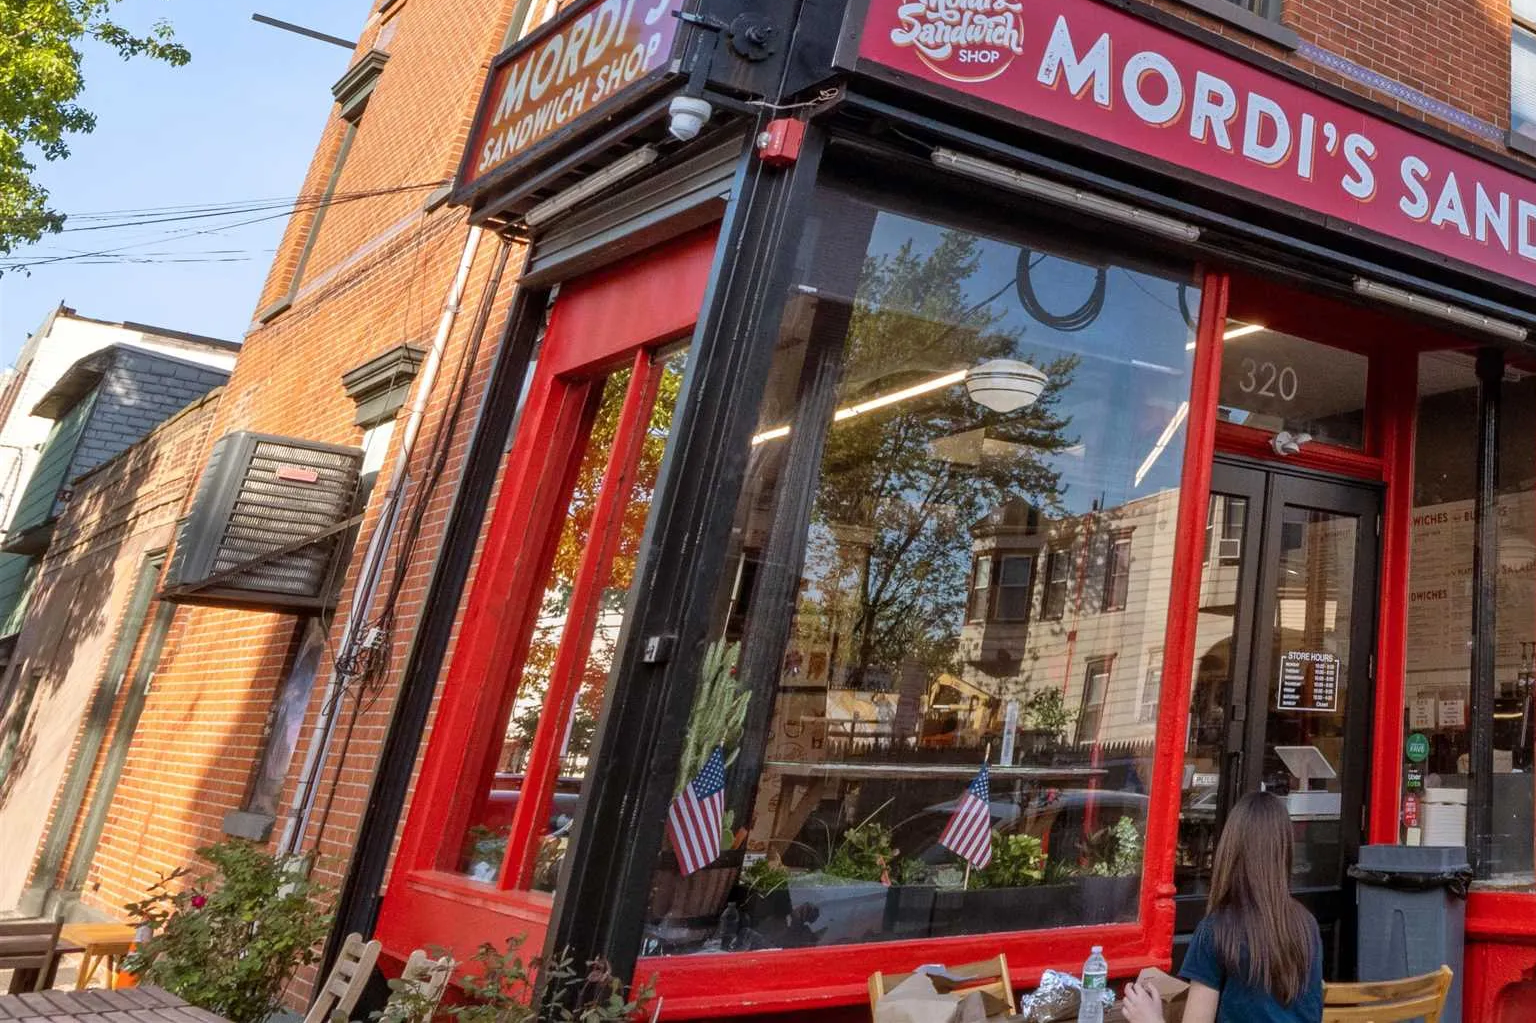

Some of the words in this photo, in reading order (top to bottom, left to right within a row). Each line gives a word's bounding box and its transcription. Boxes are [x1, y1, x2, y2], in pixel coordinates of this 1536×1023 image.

[891, 3, 1024, 60] Sandwich
[958, 49, 1000, 64] SHOP
[479, 78, 589, 171] SANDWICH
[591, 32, 661, 102] SHOP
[1036, 14, 1377, 202] MORDI'S
[1239, 357, 1298, 402] 320
[1412, 512, 1449, 526] WICHES
[1287, 651, 1310, 661] STORE
[1310, 652, 1334, 663] HOURS
